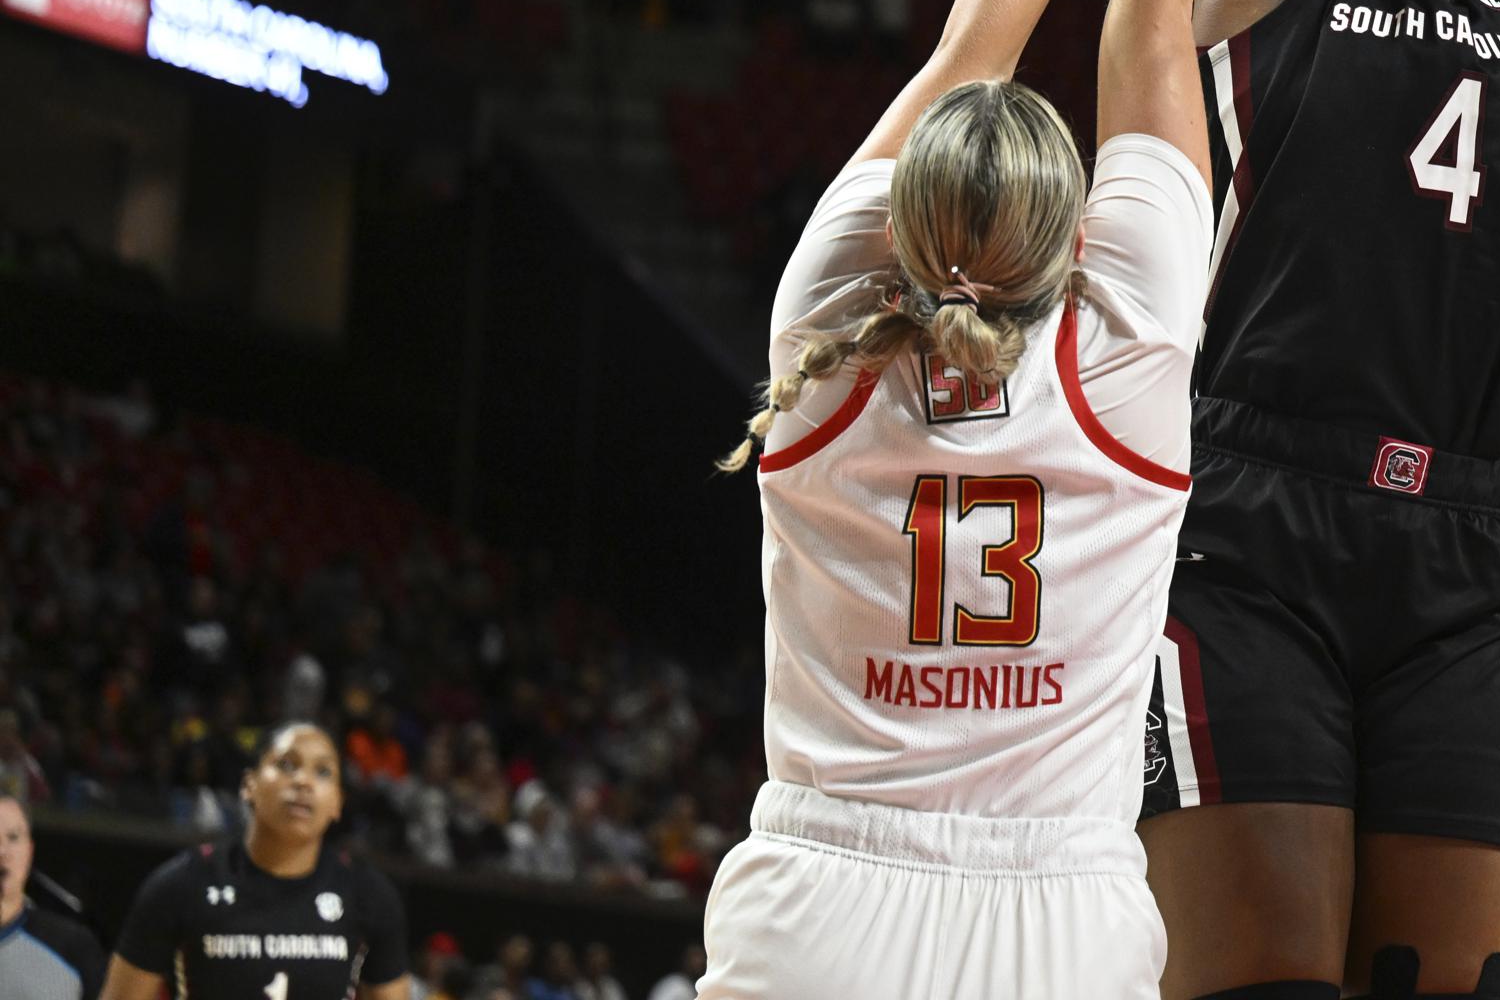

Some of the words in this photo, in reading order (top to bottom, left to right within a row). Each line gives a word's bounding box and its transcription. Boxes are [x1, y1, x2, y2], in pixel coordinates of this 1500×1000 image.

[1330, 3, 1425, 40] SOUTH
[1407, 74, 1485, 228] 4
[902, 474, 1044, 647] 13
[864, 657, 1064, 710] MASONIUS
[203, 934, 262, 960] SOUTH
[264, 934, 348, 960] CAROLINA
